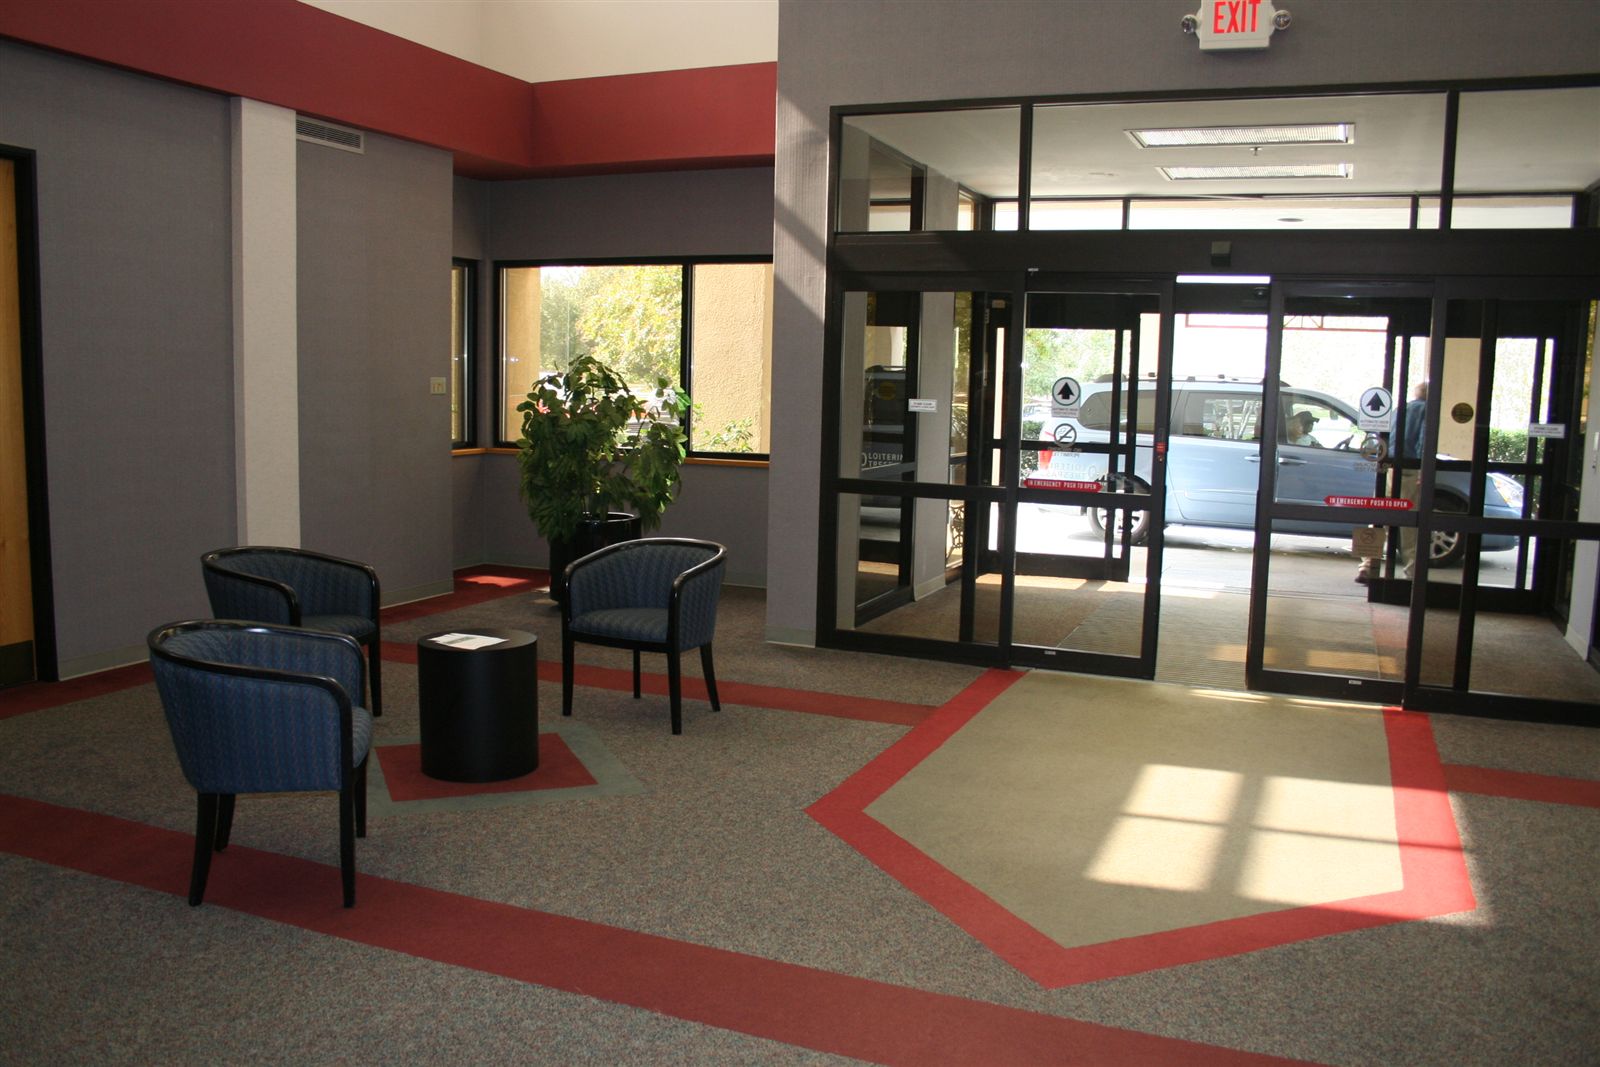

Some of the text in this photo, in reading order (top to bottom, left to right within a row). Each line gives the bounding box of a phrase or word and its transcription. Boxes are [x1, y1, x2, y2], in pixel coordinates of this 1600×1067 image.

[1213, 0, 1261, 34] EXIT
[1034, 479, 1061, 488] EMERGENCY
[1084, 482, 1097, 490] OPEN
[1336, 497, 1367, 505] EMERGENCY
[1370, 499, 1385, 507] PUSH
[1393, 500, 1408, 508] OPEN
